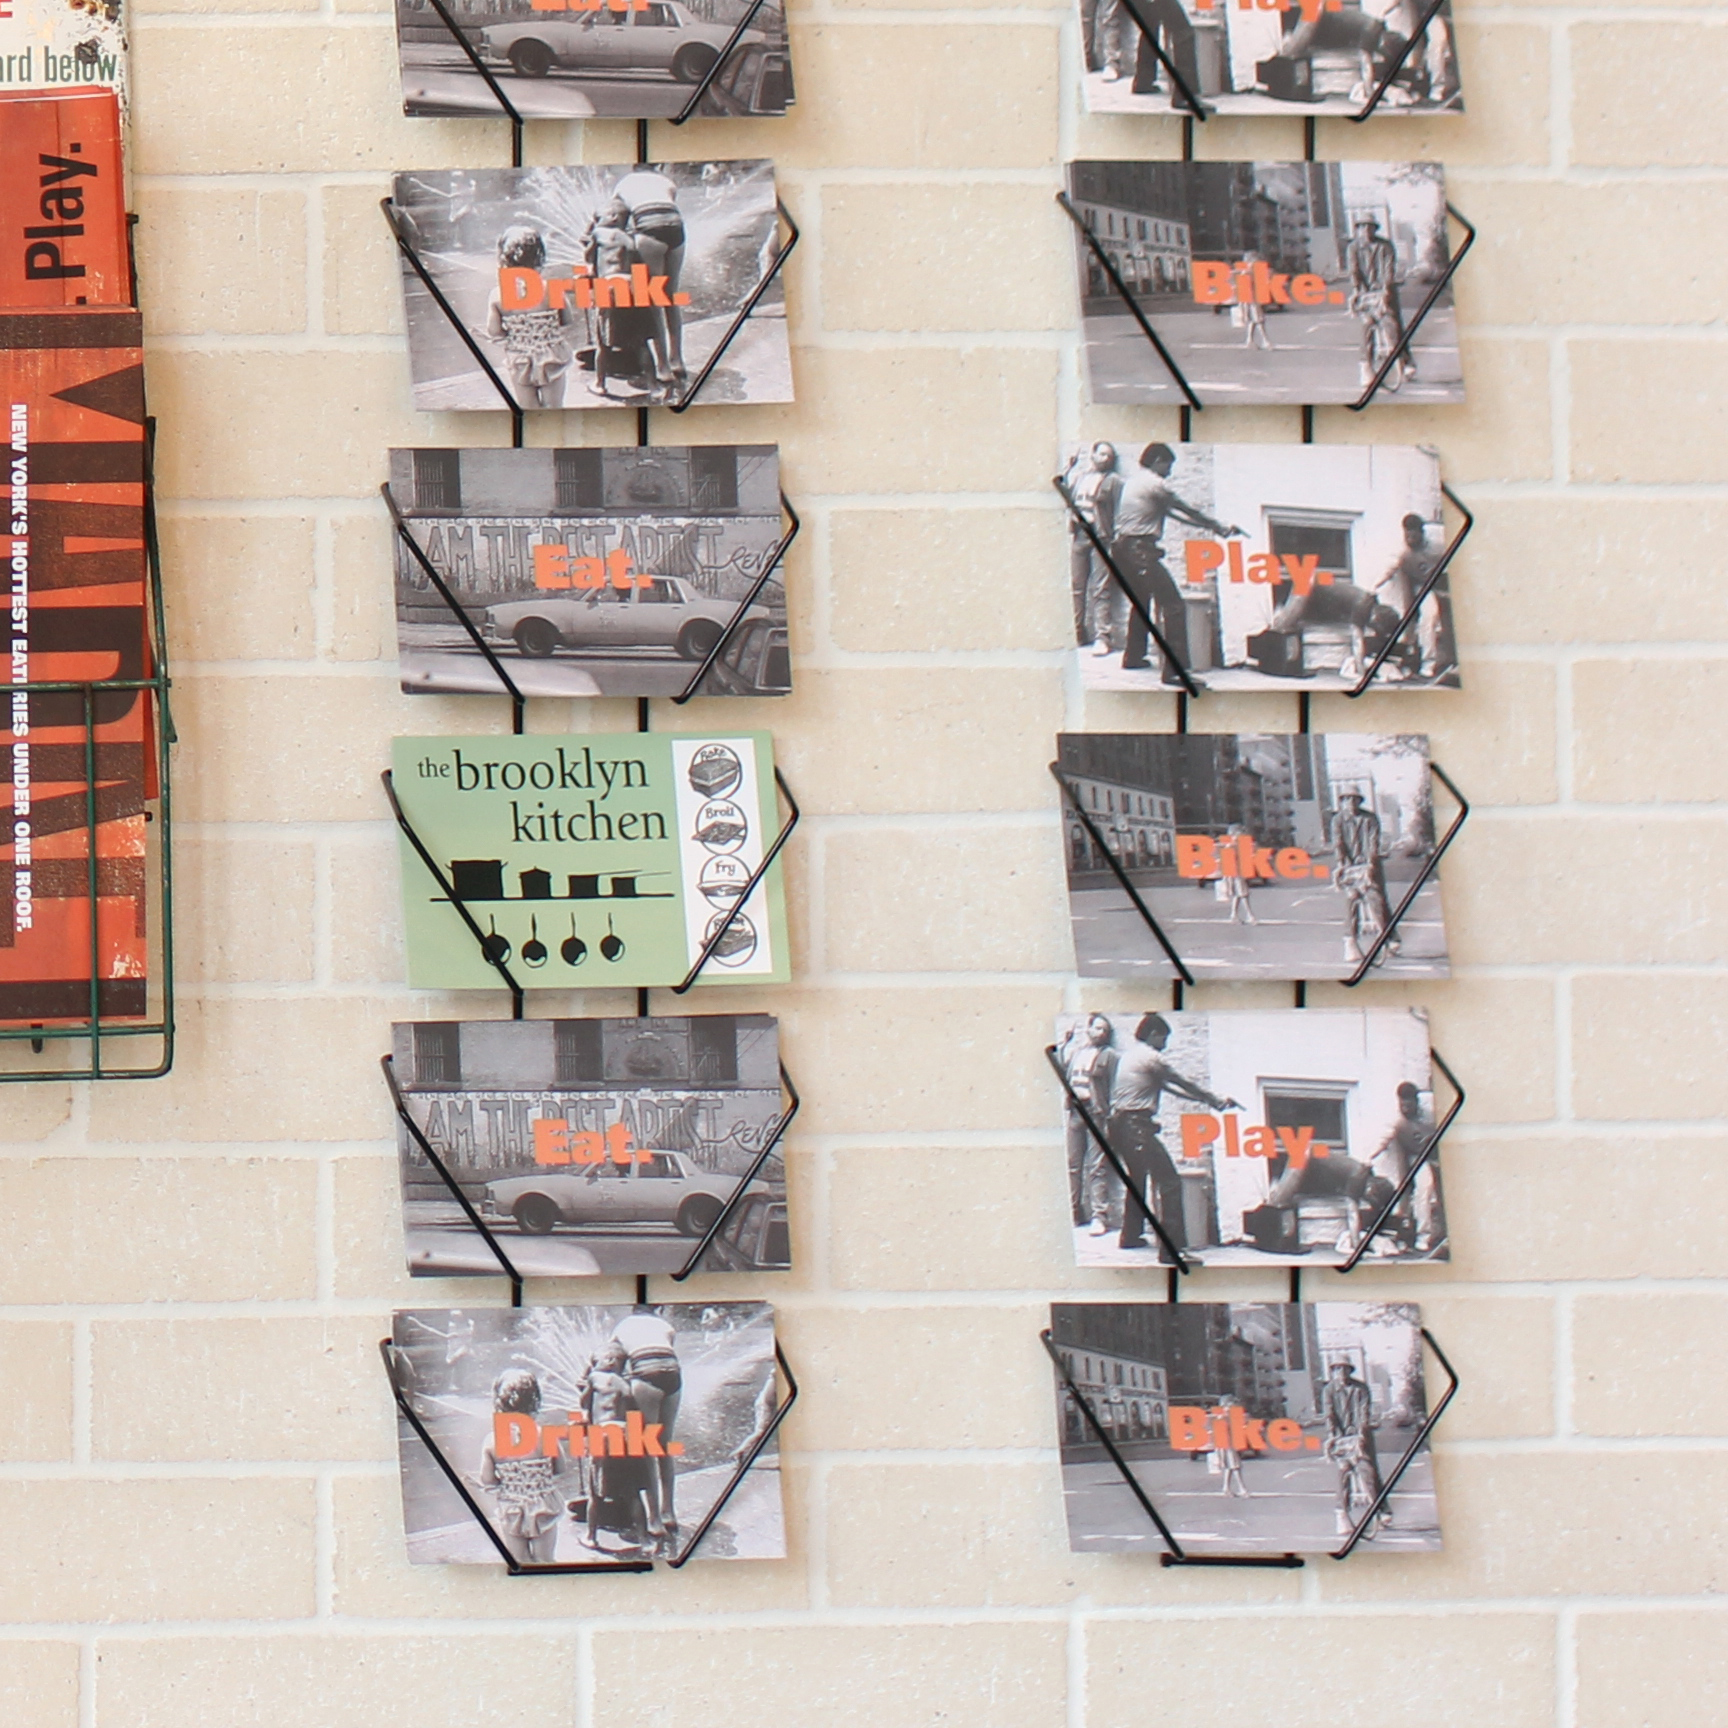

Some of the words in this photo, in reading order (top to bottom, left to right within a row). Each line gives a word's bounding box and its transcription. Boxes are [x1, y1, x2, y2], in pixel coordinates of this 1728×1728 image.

[23, 141, 99, 281] Play.
[499, 263, 689, 310] Drink.
[1192, 261, 1343, 304] Bike.
[11, 404, 29, 452] NEW
[10, 456, 29, 535] YORK'S
[11, 541, 29, 634] HOTTEST
[534, 545, 653, 589] Eat.
[1185, 540, 1333, 596] Play.
[13, 742, 31, 816] UNDER
[415, 756, 451, 778] the
[450, 741, 652, 806] brooklyn
[505, 795, 669, 846] kitchen
[704, 806, 735, 818] Broil
[14, 821, 31, 866] ONE
[1176, 835, 1327, 879] Bike.
[713, 859, 738, 876] Fry
[14, 871, 33, 933] ROOF.
[535, 1120, 653, 1165] Eat.
[1182, 1114, 1328, 1168] Play.
[495, 1412, 682, 1458] Drink.
[1169, 1406, 1318, 1451] Bike.
